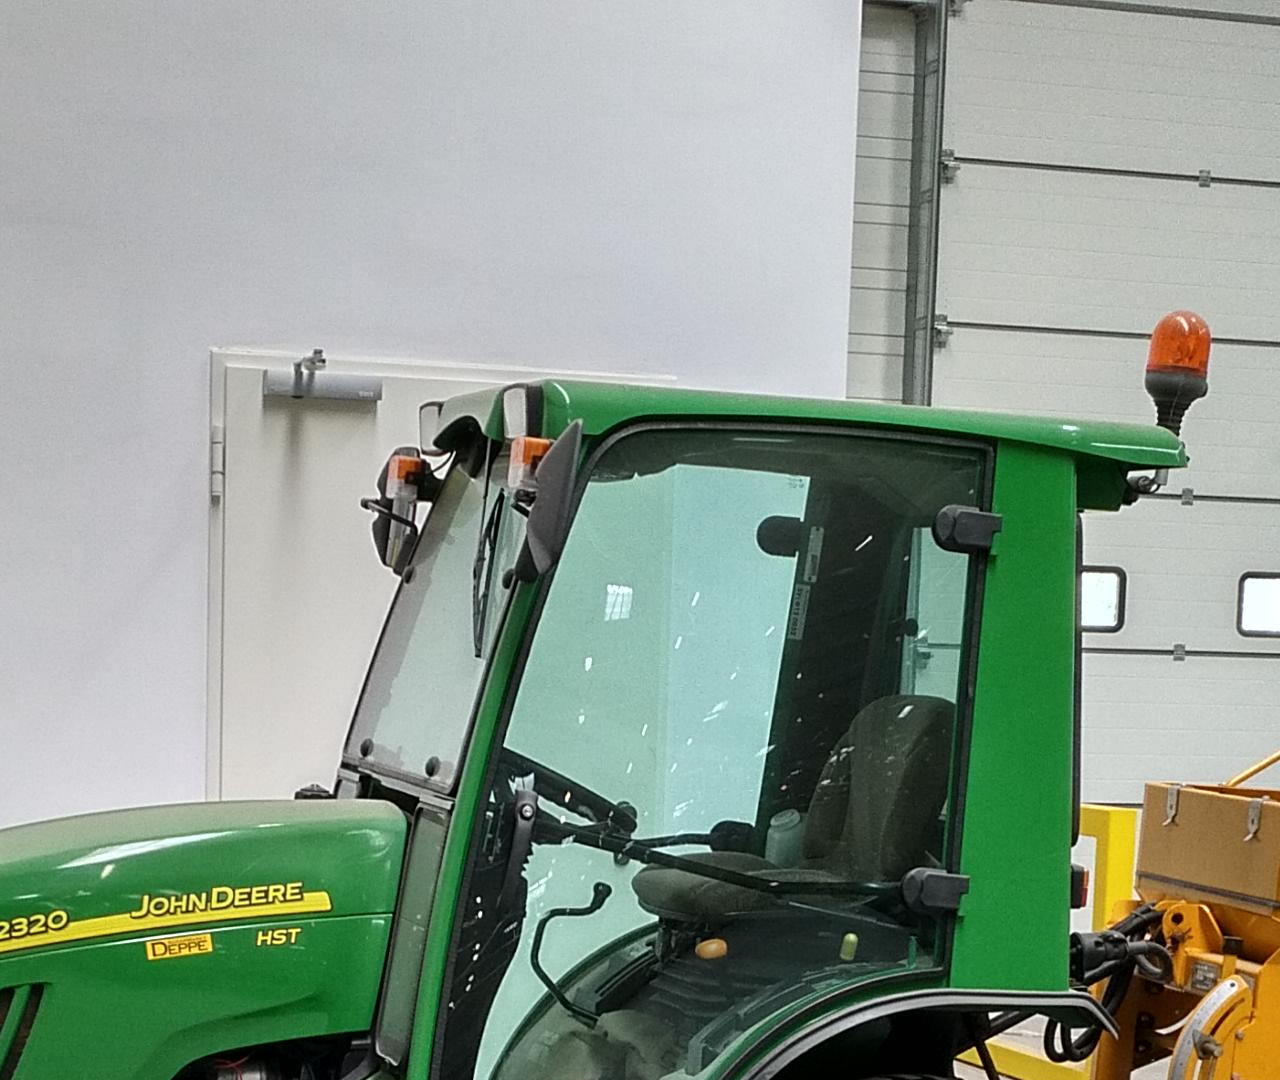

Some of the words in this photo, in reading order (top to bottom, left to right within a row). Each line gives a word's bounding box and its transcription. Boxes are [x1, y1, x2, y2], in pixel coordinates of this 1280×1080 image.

[129, 893, 207, 919] JOHN
[209, 881, 305, 910] DEERE
[256, 927, 302, 947] HST
[151, 940, 209, 957] DEPPE
